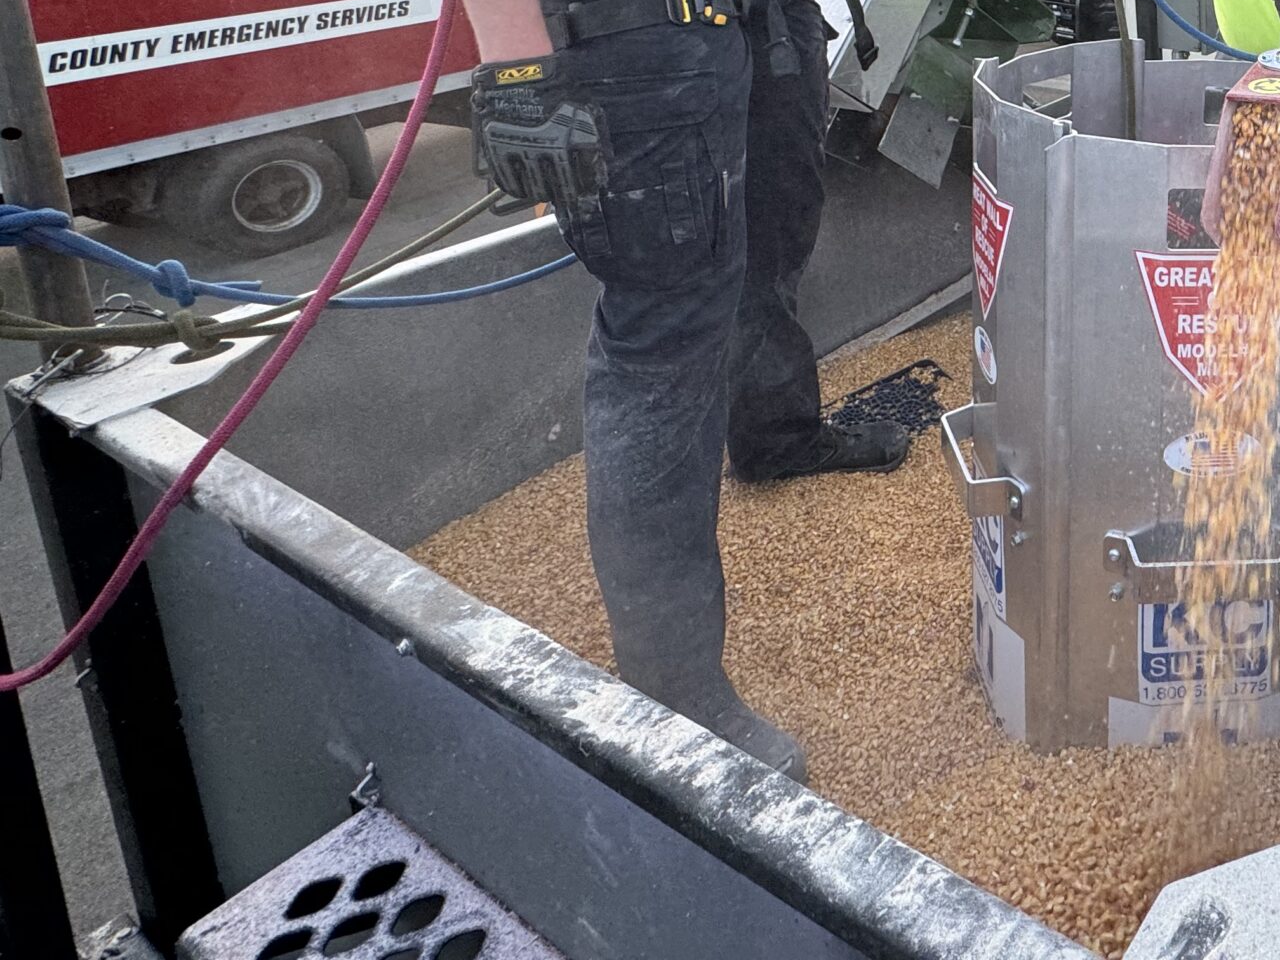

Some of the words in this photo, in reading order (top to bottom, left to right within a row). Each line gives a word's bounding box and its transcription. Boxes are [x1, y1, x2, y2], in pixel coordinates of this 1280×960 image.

[48, 37, 162, 74] COUNTY
[170, 14, 310, 55] EMERGENCY
[315, 0, 411, 31] SERVICES
